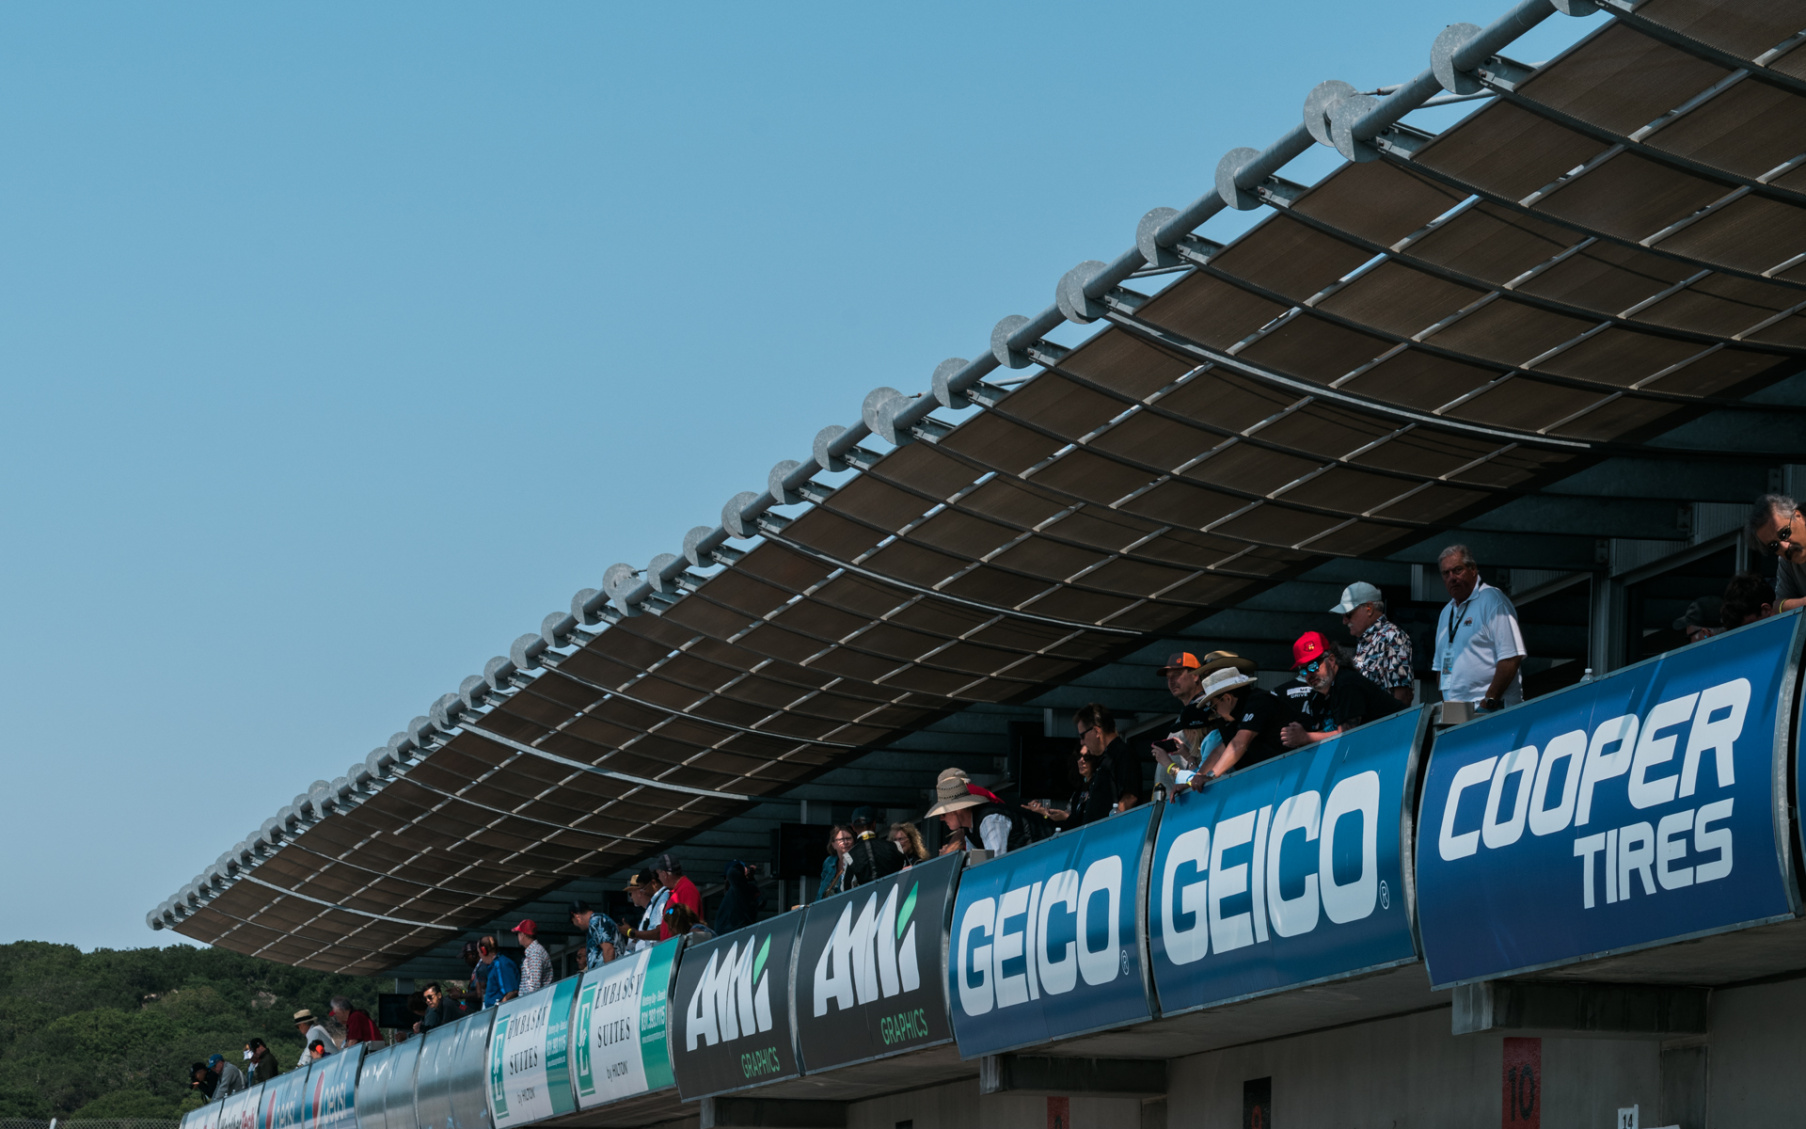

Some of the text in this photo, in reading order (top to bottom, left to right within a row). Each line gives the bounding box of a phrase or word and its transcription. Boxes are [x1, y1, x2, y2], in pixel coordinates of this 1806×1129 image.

[1438, 677, 1751, 861] COOPER
[1161, 769, 1381, 966] GEICO
[1573, 798, 1734, 910] TIRES
[957, 854, 1123, 1017] GEICO
[594, 973, 645, 1010] EMBASSY
[506, 1004, 549, 1040] EMBASSY
[597, 1016, 631, 1049] SUITES
[880, 1008, 929, 1046] GRAPHICS
[509, 1047, 538, 1075] SUITES
[612, 1061, 628, 1076] HILTON
[741, 1047, 780, 1079] GRAPHICS
[1508, 1063, 1535, 1122] 10
